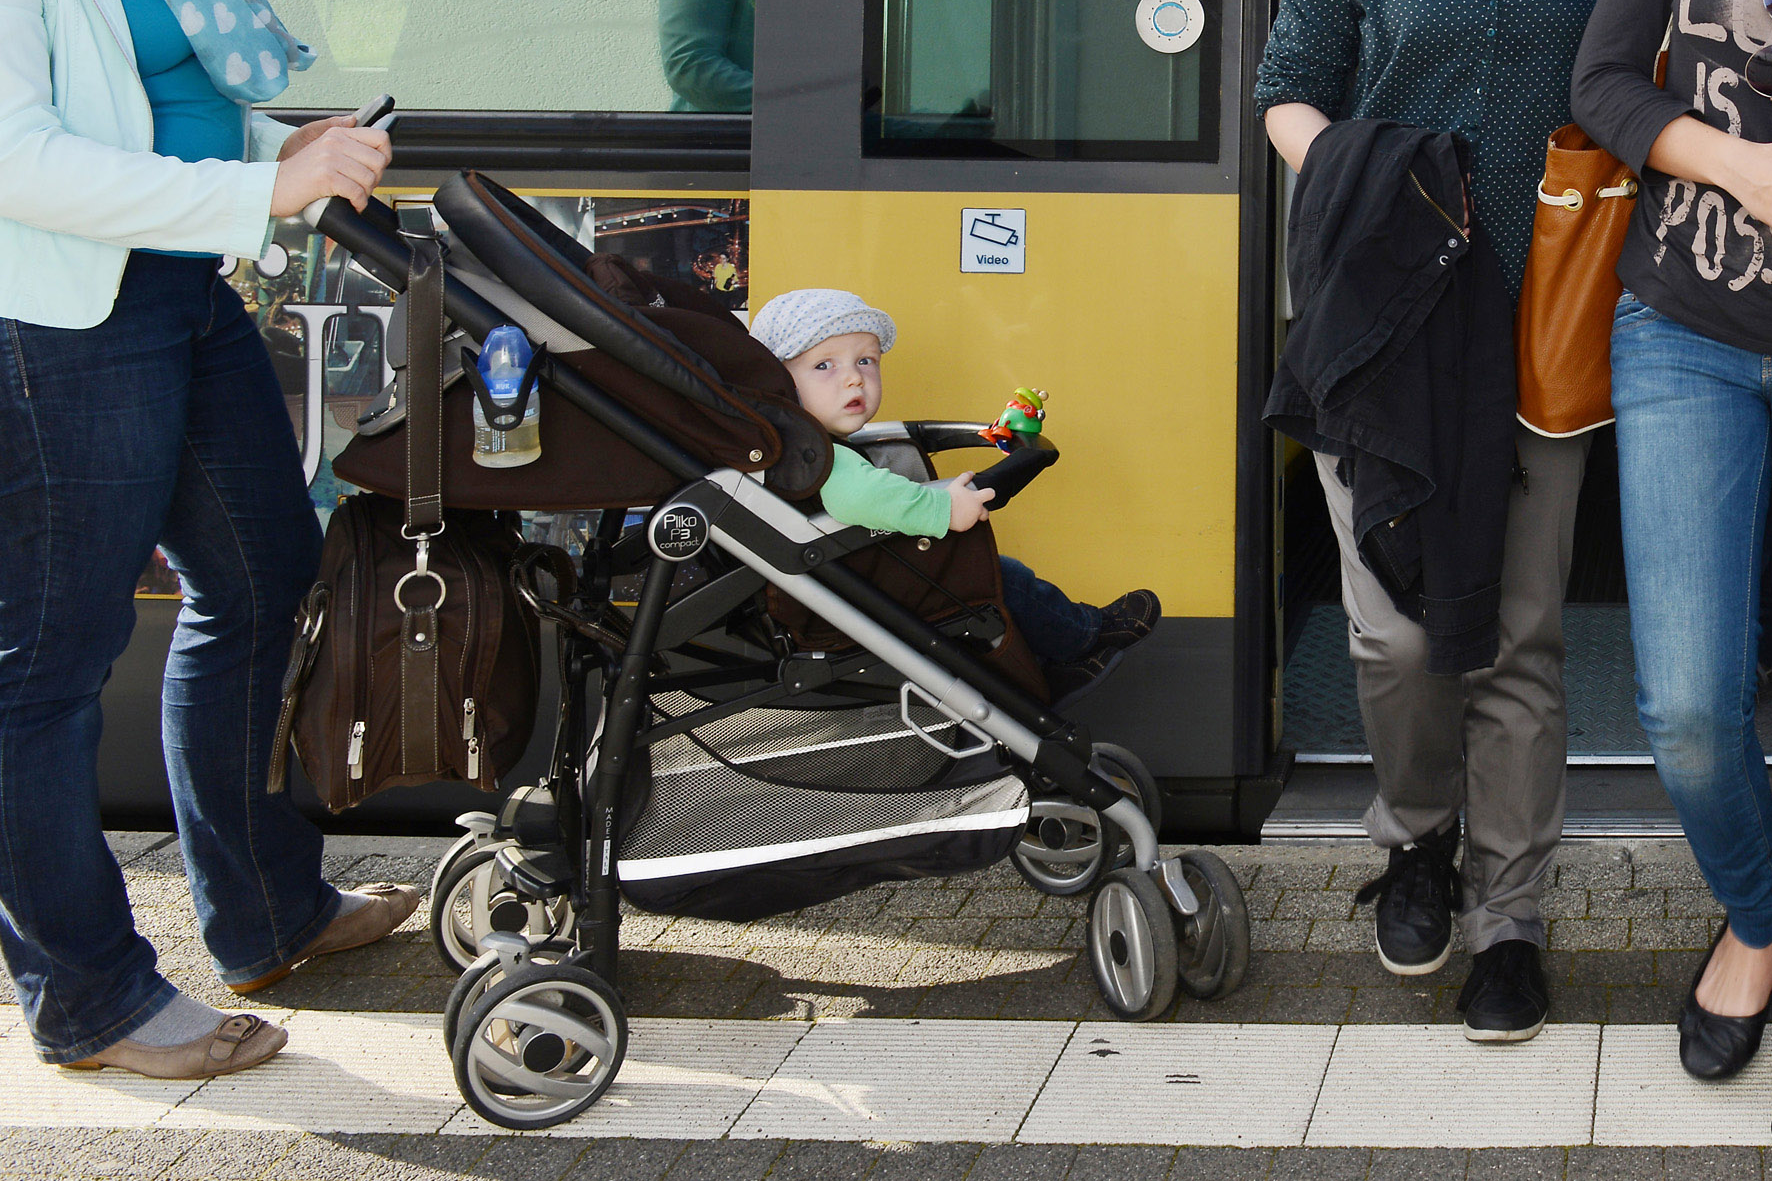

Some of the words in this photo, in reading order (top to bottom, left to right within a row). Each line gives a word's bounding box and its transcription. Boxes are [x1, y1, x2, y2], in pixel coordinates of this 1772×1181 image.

[1694, 61, 1742, 138] IS
[976, 254, 1009, 265] Video
[663, 513, 698, 530] Pliko
[670, 528, 691, 541] P3
[660, 535, 701, 551] compact
[605, 806, 613, 835] MADE
